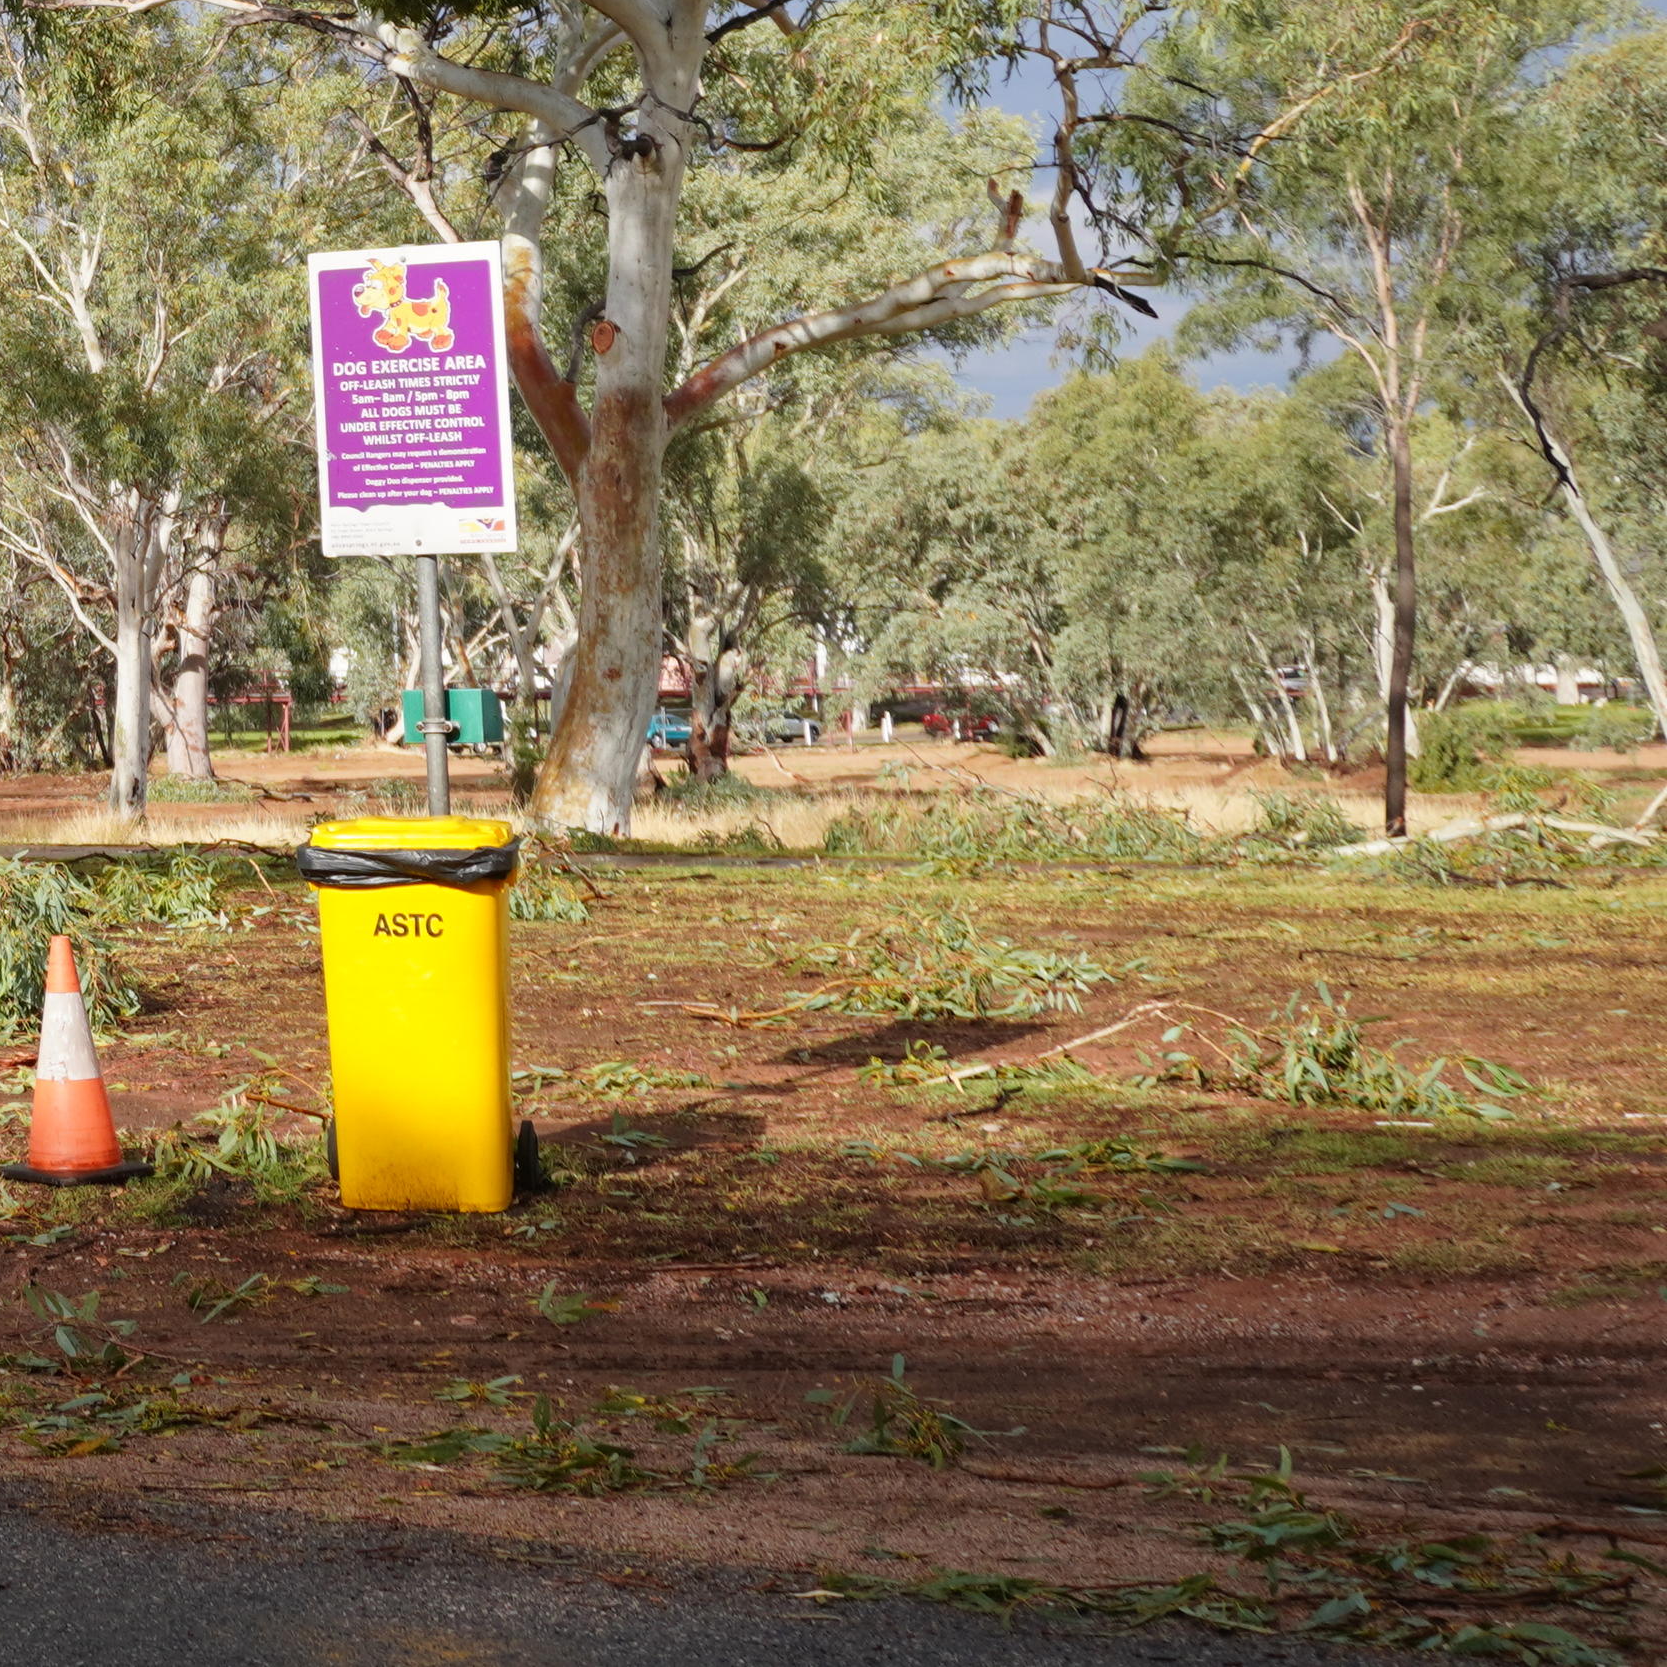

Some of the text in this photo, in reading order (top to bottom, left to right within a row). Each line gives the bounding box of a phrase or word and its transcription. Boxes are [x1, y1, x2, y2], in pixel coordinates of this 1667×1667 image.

[333, 354, 486, 376] DOG EXERCISE AREA
[340, 374, 480, 391] OFF-LEASH TIMES STRICTLY
[382, 392, 405, 403] 8am
[415, 391, 438, 403] 5pm
[446, 389, 470, 401] 8pm
[361, 403, 462, 418] ALL DOGS MUST BE
[340, 416, 485, 433] UNDER EFFECTIVE CONTROL
[363, 431, 463, 446] WHILST OFF-LEASH
[341, 452, 365, 460] Council
[365, 452, 391, 460] Rangers
[392, 451, 406, 459] may
[407, 450, 432, 458] request
[438, 447, 487, 456] demonstration
[361, 464, 388, 472] Effective
[389, 462, 414, 470] Control
[420, 461, 454, 469] PENALTIES
[455, 460, 475, 468] APPLY
[365, 478, 386, 486] Doggy
[401, 477, 432, 485] dispenser
[337, 491, 358, 499] Please
[387, 489, 402, 497] after
[419, 489, 432, 497] dog
[439, 487, 473, 495] PENALTIES
[473, 486, 494, 494] APPLY
[373, 913, 444, 938] ASTC
